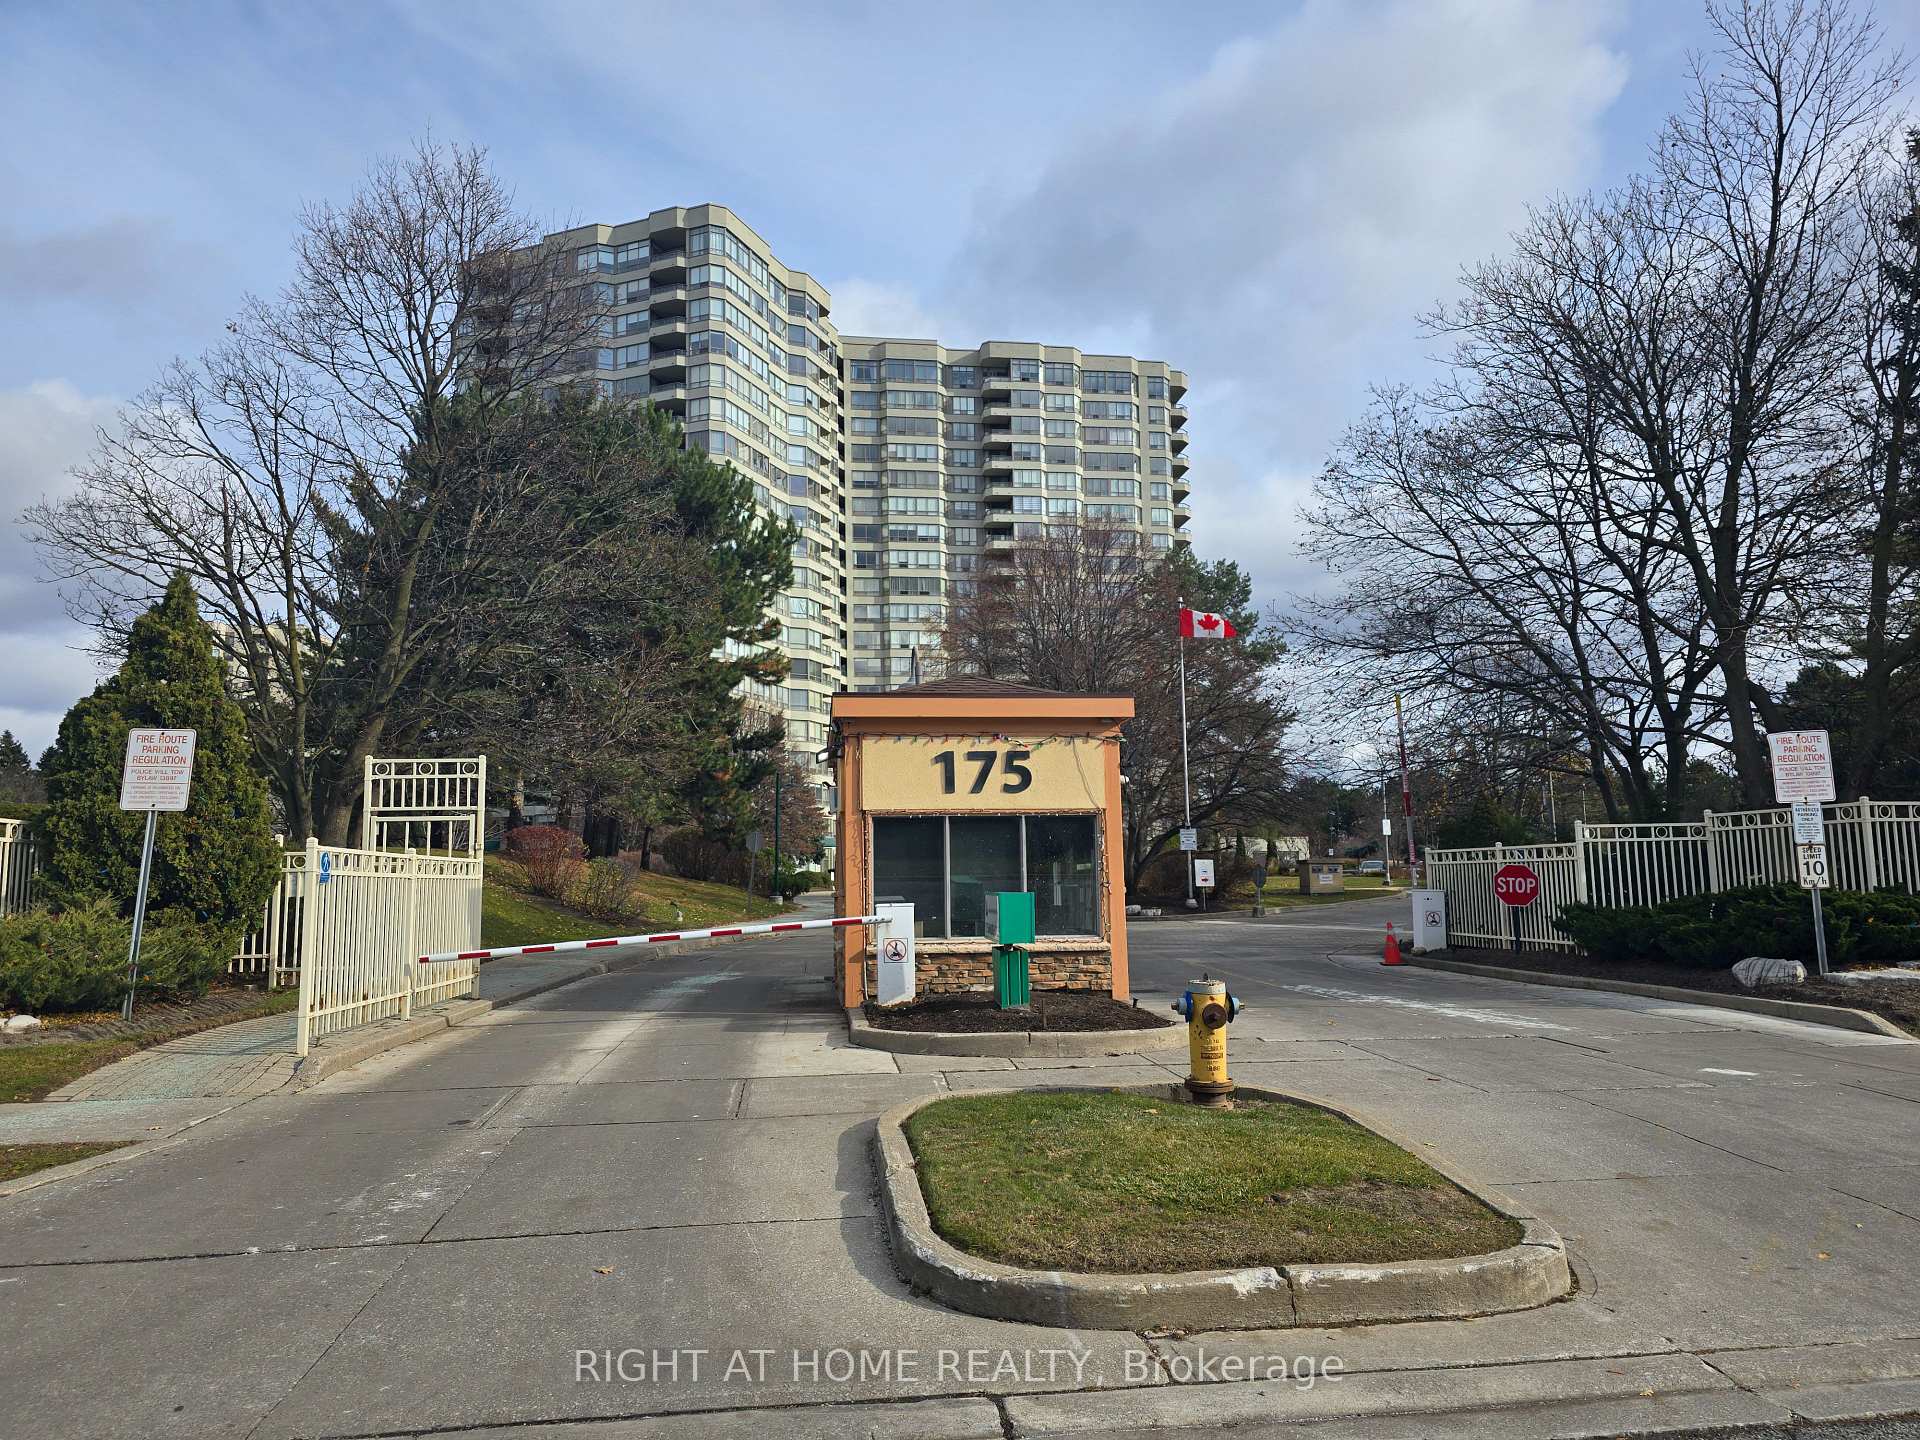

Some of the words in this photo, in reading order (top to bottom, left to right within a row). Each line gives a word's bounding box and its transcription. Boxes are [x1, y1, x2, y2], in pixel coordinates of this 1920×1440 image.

[136, 735, 155, 744] FIRE
[159, 735, 188, 744] ROUTE
[1776, 736, 1793, 745] FIRE
[1796, 735, 1822, 744] ROUTE
[142, 745, 180, 754] PARKING
[1783, 745, 1817, 753] PARKING
[132, 755, 187, 765] REGULATION
[1777, 753, 1826, 763] REGULATION
[932, 750, 1033, 794] 175
[1802, 860, 1825, 876] 10
[1497, 877, 1536, 893] STOP
[1803, 876, 1827, 886] Km/h
